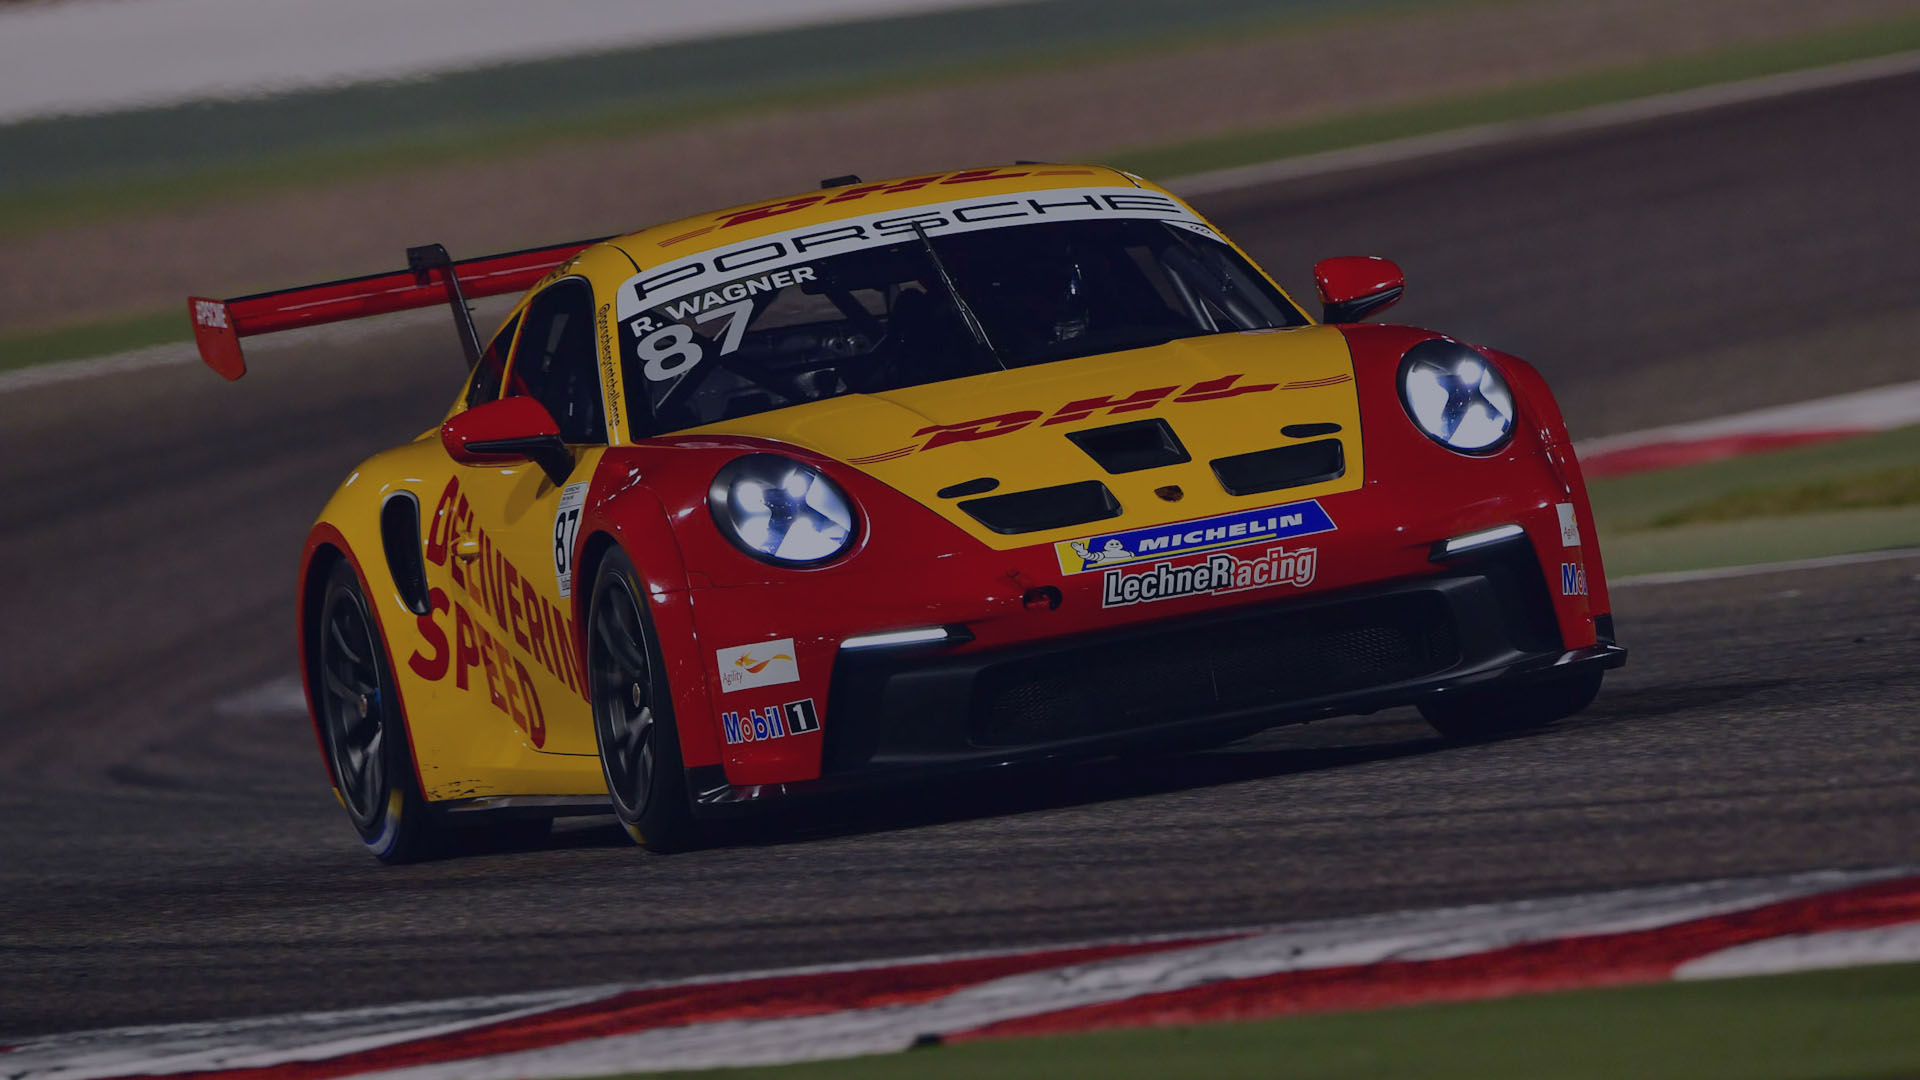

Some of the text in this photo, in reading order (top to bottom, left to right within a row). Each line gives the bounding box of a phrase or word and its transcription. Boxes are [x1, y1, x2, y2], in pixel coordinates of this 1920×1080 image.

[715, 168, 1031, 229] DHL
[634, 194, 1182, 302] PORSCHE
[630, 266, 817, 338] R. WAGNER
[637, 299, 754, 382] 87
[912, 374, 1280, 452] DHL
[555, 508, 579, 574] 87
[1138, 512, 1303, 553] MICHELIN
[408, 587, 546, 749] SPEED
[722, 669, 743, 686] Agility
[722, 705, 785, 744] Mobil
